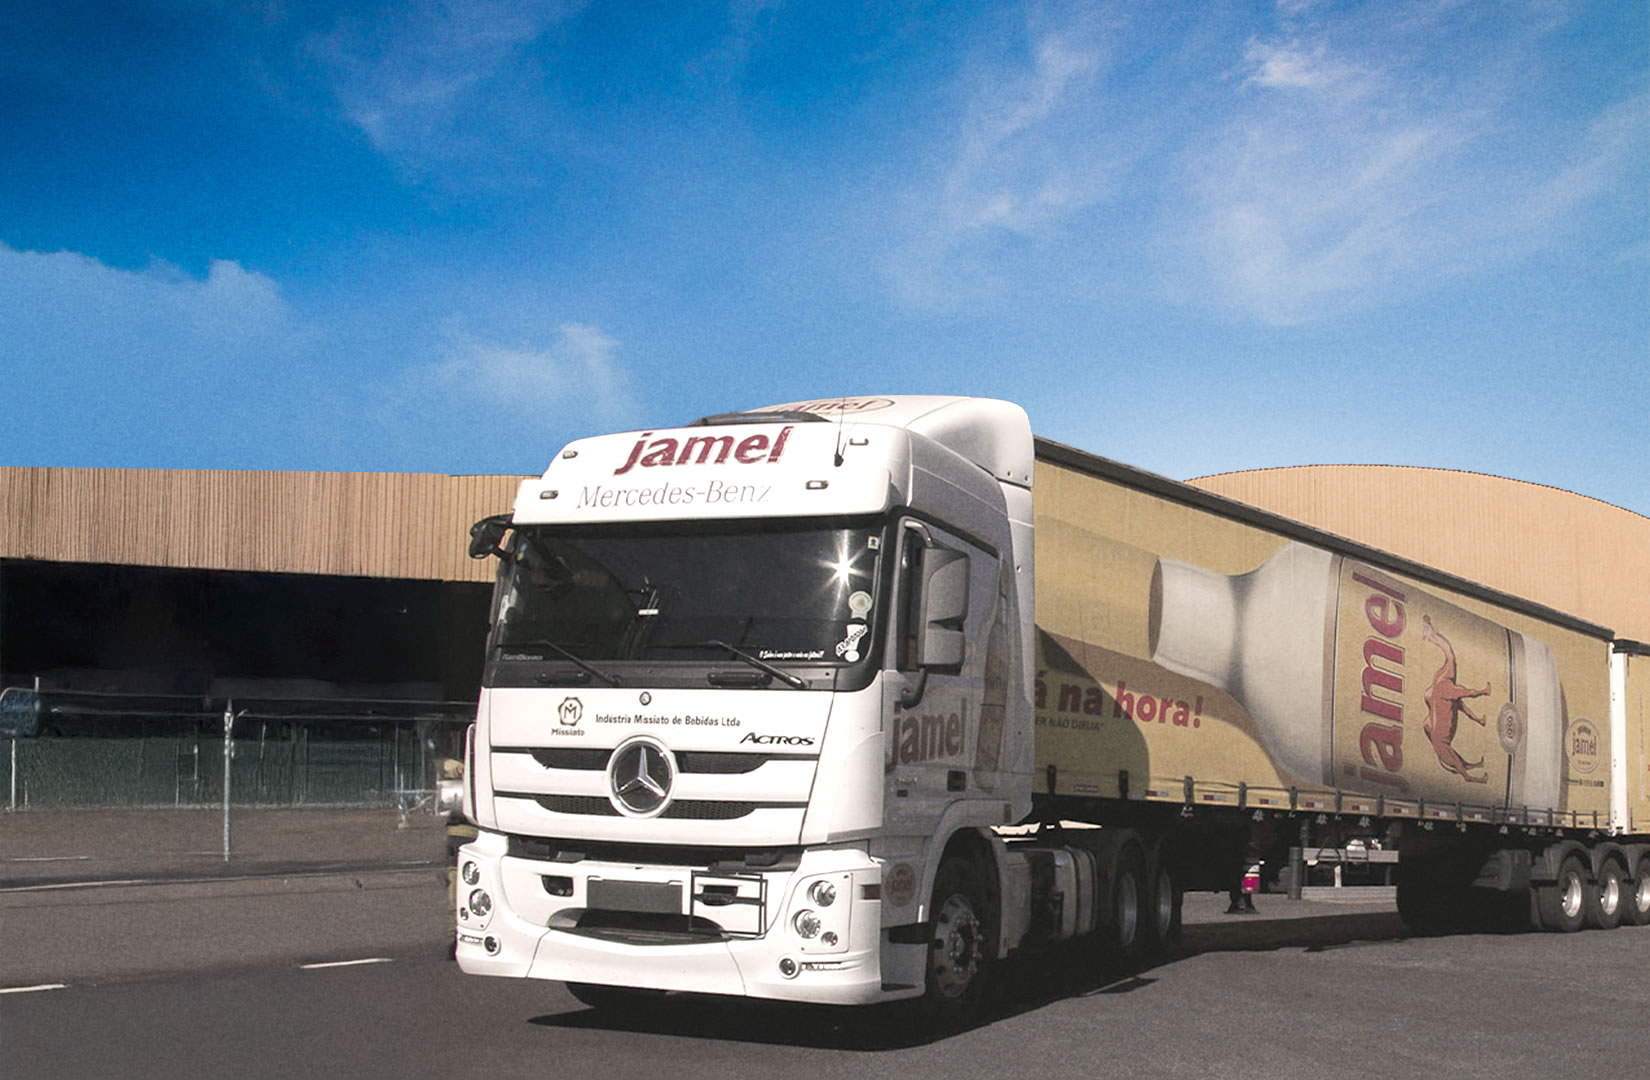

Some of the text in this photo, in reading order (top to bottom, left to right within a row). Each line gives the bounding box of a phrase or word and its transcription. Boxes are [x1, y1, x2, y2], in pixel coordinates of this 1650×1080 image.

[613, 425, 795, 476] jamel
[576, 479, 772, 509] Mercedes-Benz
[1058, 683, 1104, 716] na
[1112, 680, 1203, 729] hora!
[1344, 571, 1409, 794] jamel
[551, 728, 585, 736] Missiato
[634, 714, 669, 725] Missiato
[672, 715, 682, 724] de
[685, 715, 719, 726] Bebidas
[721, 717, 741, 727] Ltda
[885, 697, 968, 776] jamel
